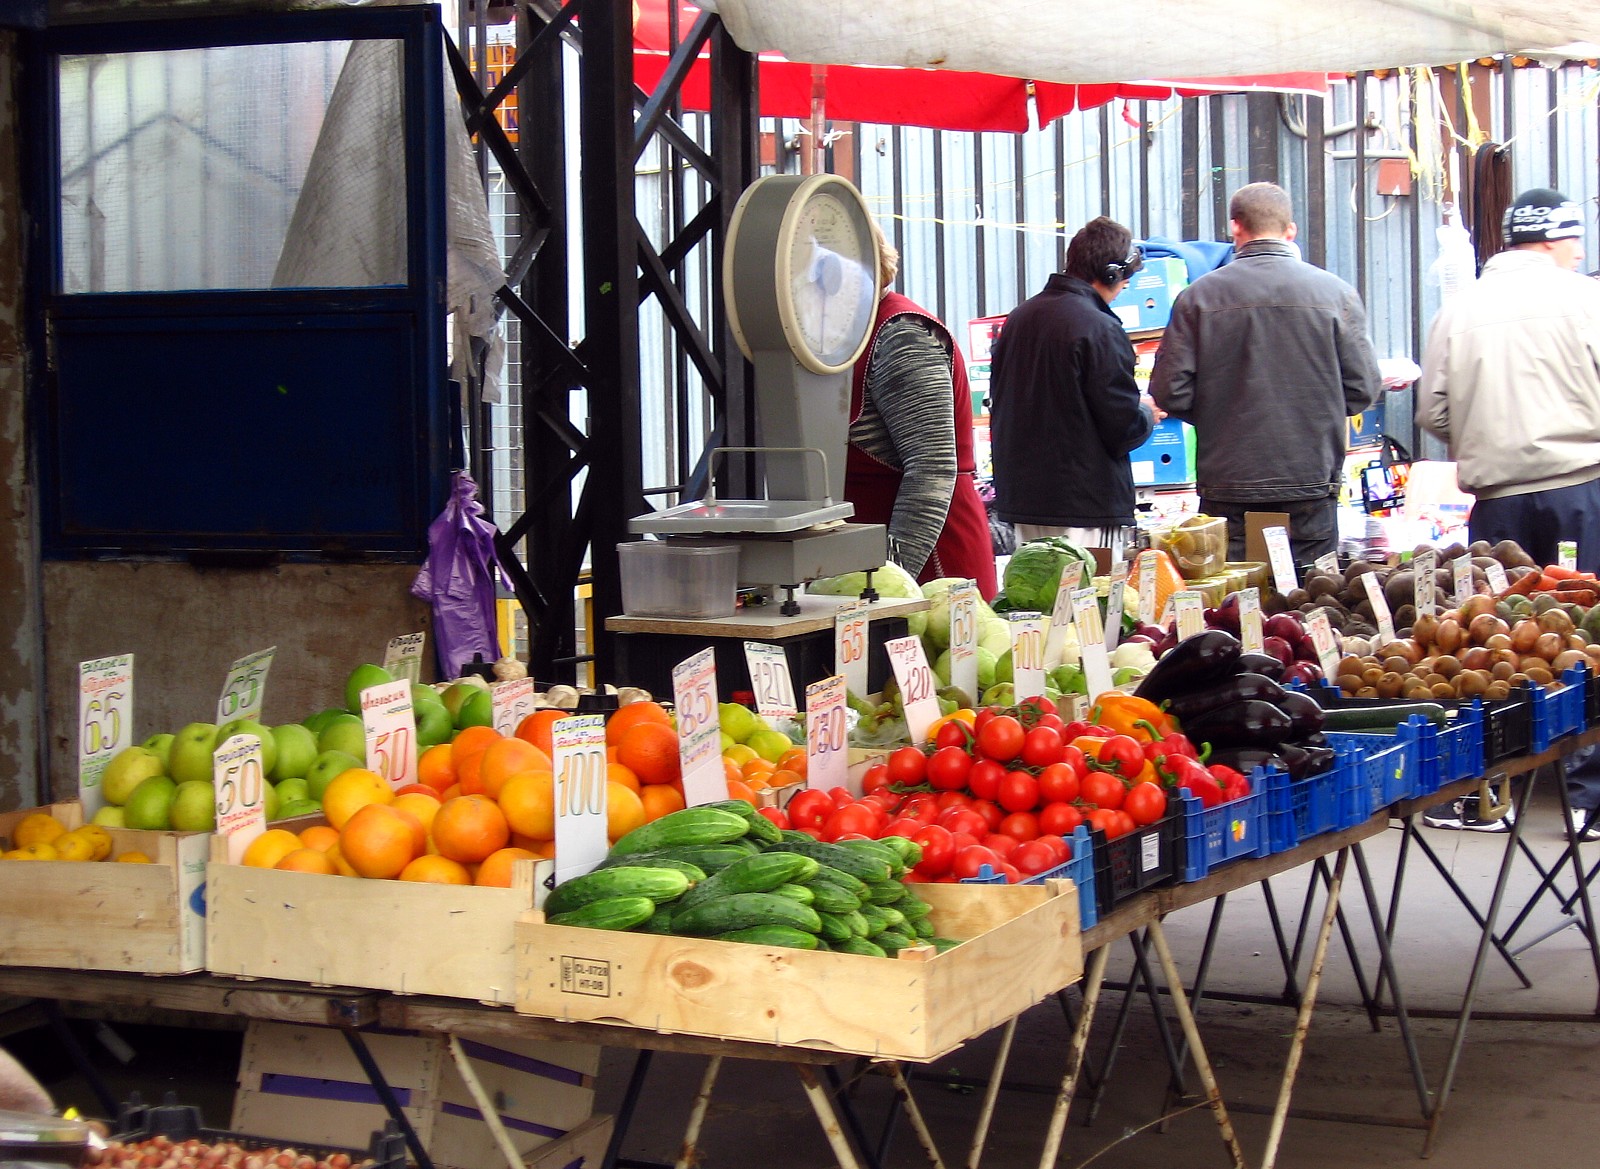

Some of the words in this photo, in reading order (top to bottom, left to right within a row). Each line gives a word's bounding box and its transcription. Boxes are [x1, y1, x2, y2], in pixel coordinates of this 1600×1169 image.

[841, 620, 865, 664] 65
[222, 669, 265, 716] 65
[681, 682, 712, 737] 85
[753, 662, 792, 707] 120
[903, 665, 930, 706] 120
[84, 691, 125, 755] 65
[809, 706, 845, 756] 130
[374, 727, 409, 781] 50
[218, 758, 260, 816] 50
[558, 750, 605, 818] 100
